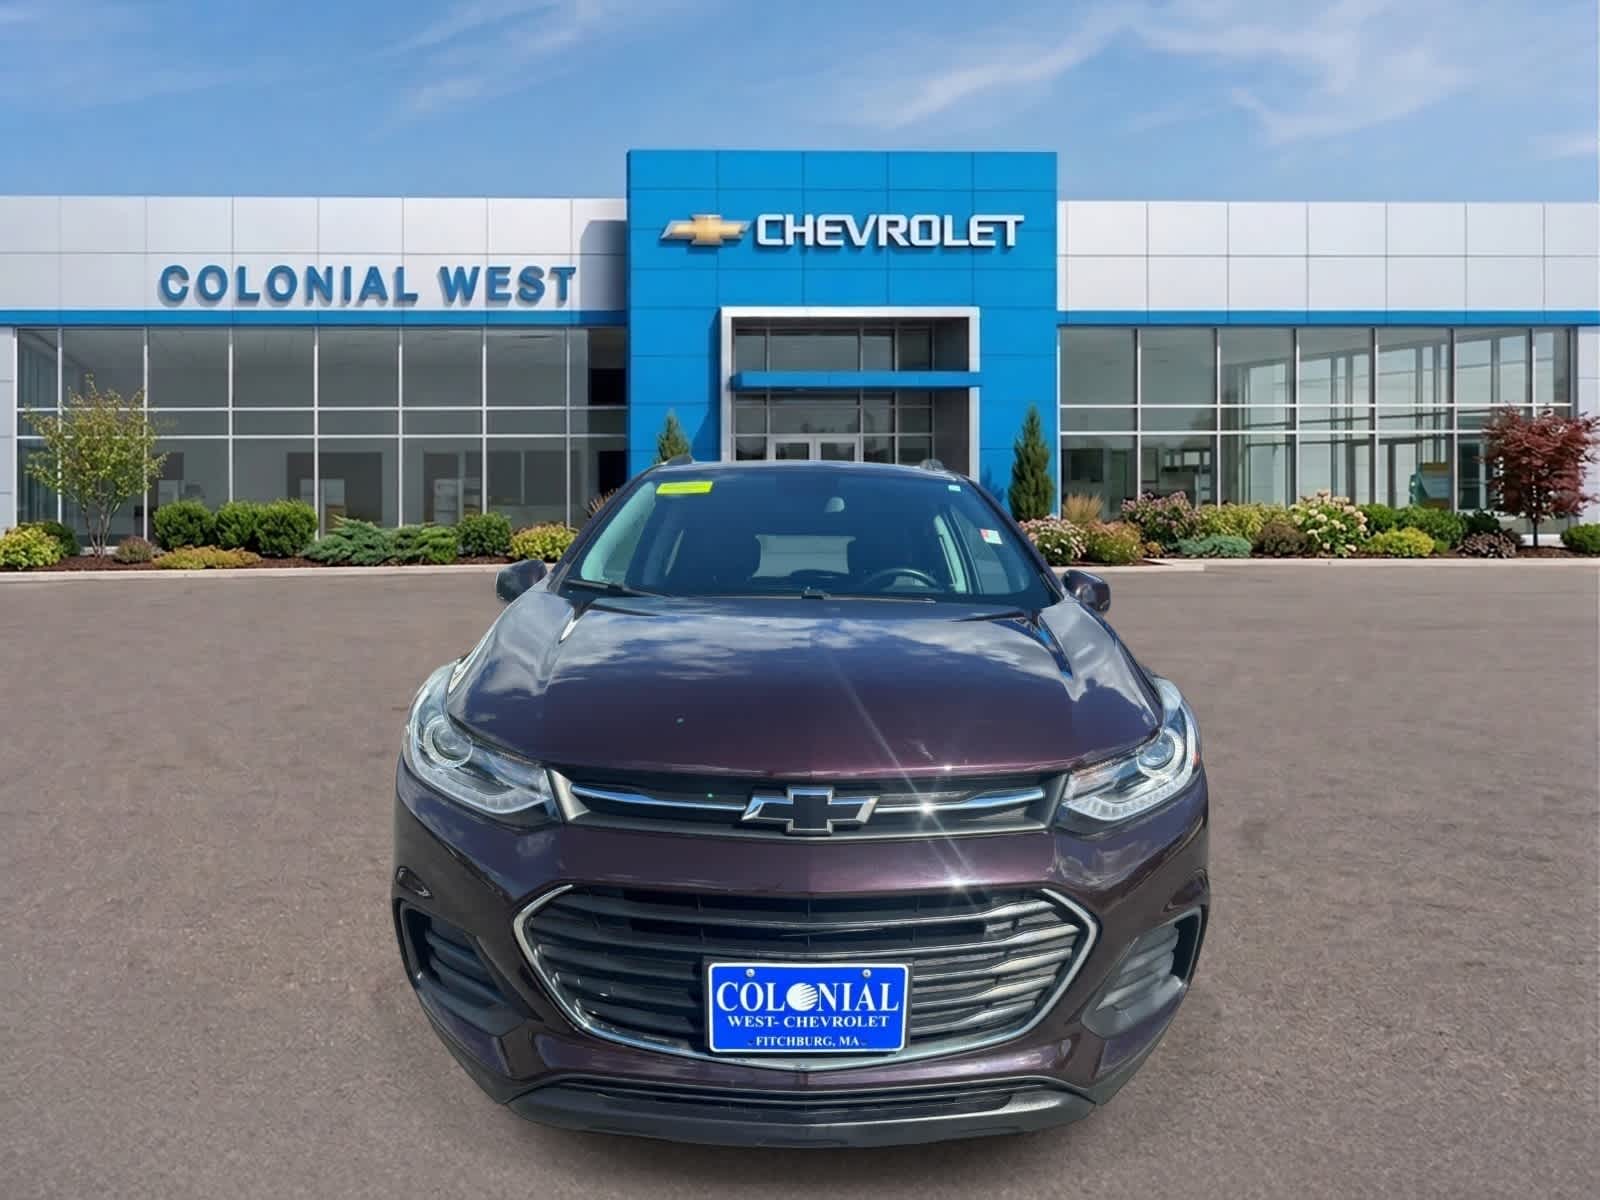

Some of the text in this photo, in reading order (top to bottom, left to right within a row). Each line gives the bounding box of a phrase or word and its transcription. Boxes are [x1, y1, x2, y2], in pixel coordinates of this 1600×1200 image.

[757, 213, 1025, 247] CHEVROLET
[159, 264, 577, 303] COLONIAL WEST
[716, 981, 899, 1012] COLONIAL
[783, 1015, 890, 1028] CHEVROLET
